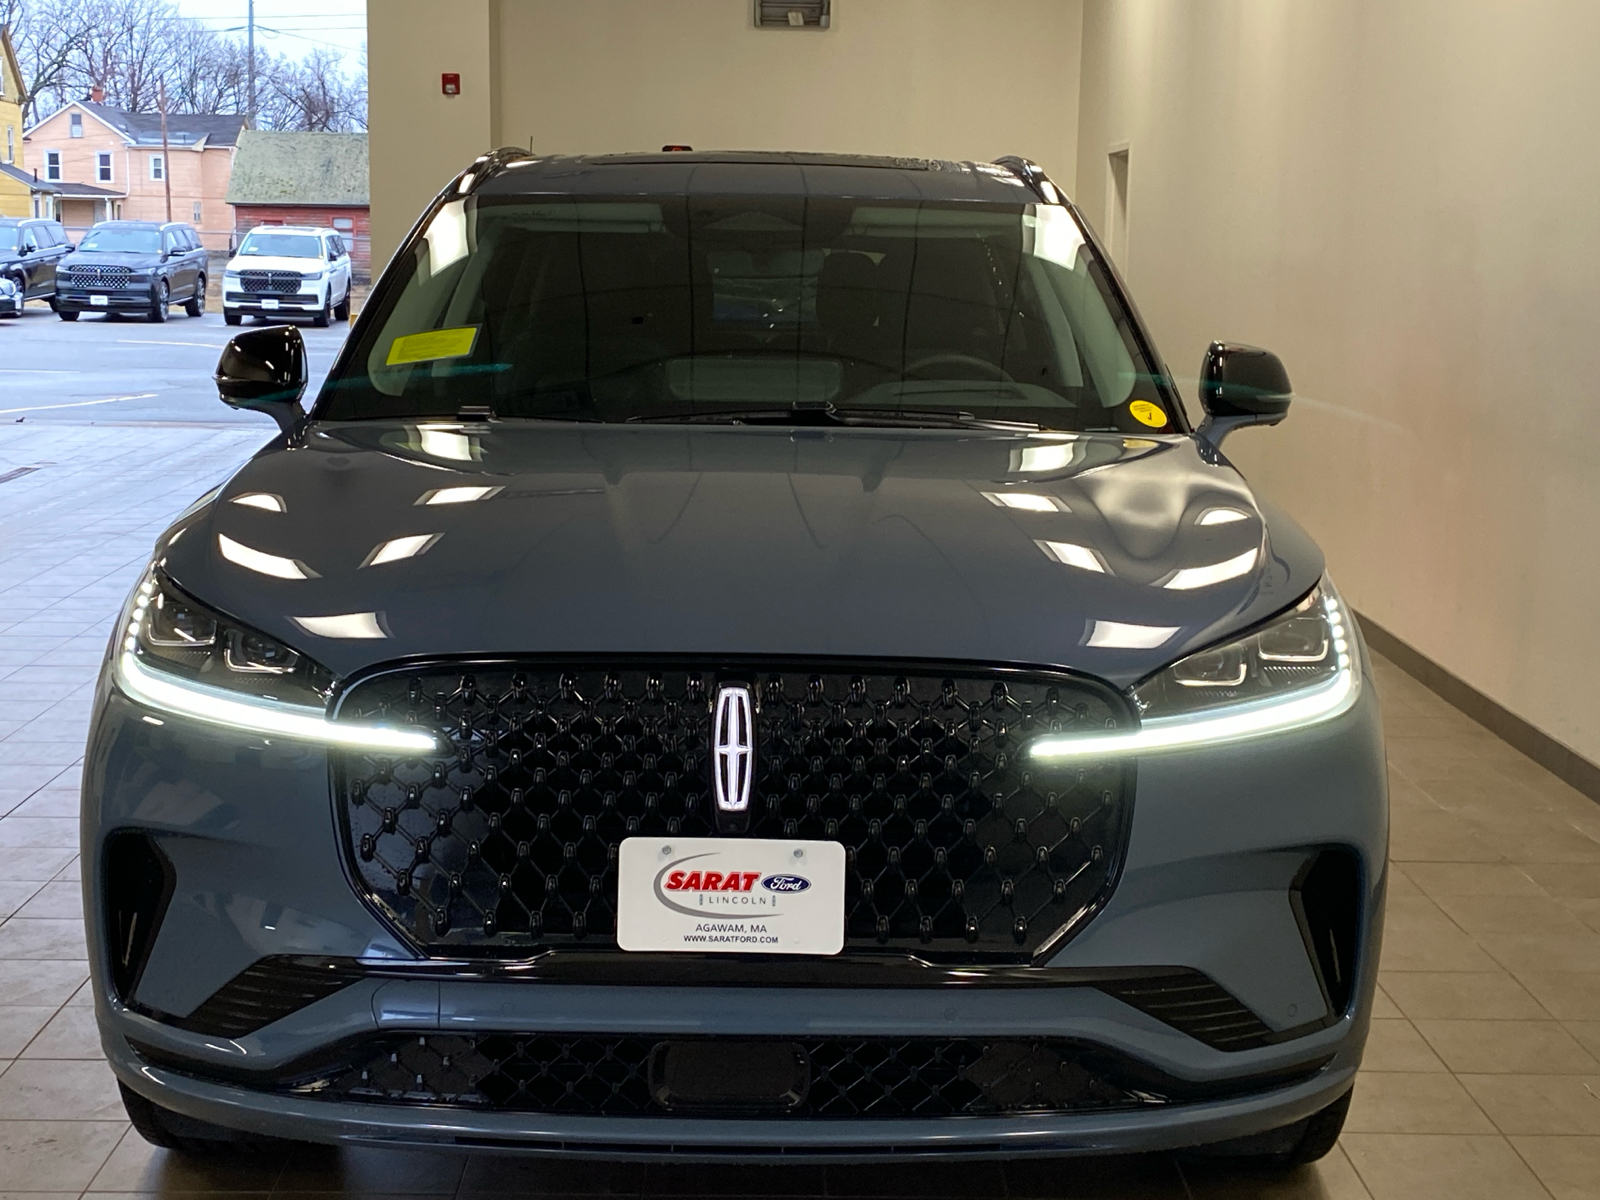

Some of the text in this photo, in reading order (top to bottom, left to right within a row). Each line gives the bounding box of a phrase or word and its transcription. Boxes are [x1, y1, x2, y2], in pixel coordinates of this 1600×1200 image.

[664, 870, 803, 893] SARAT Ford
[709, 896, 766, 905] LINCOLN
[695, 923, 768, 934] AGAWAM, MA
[684, 935, 779, 944] WWW.SARATFORD.COM
